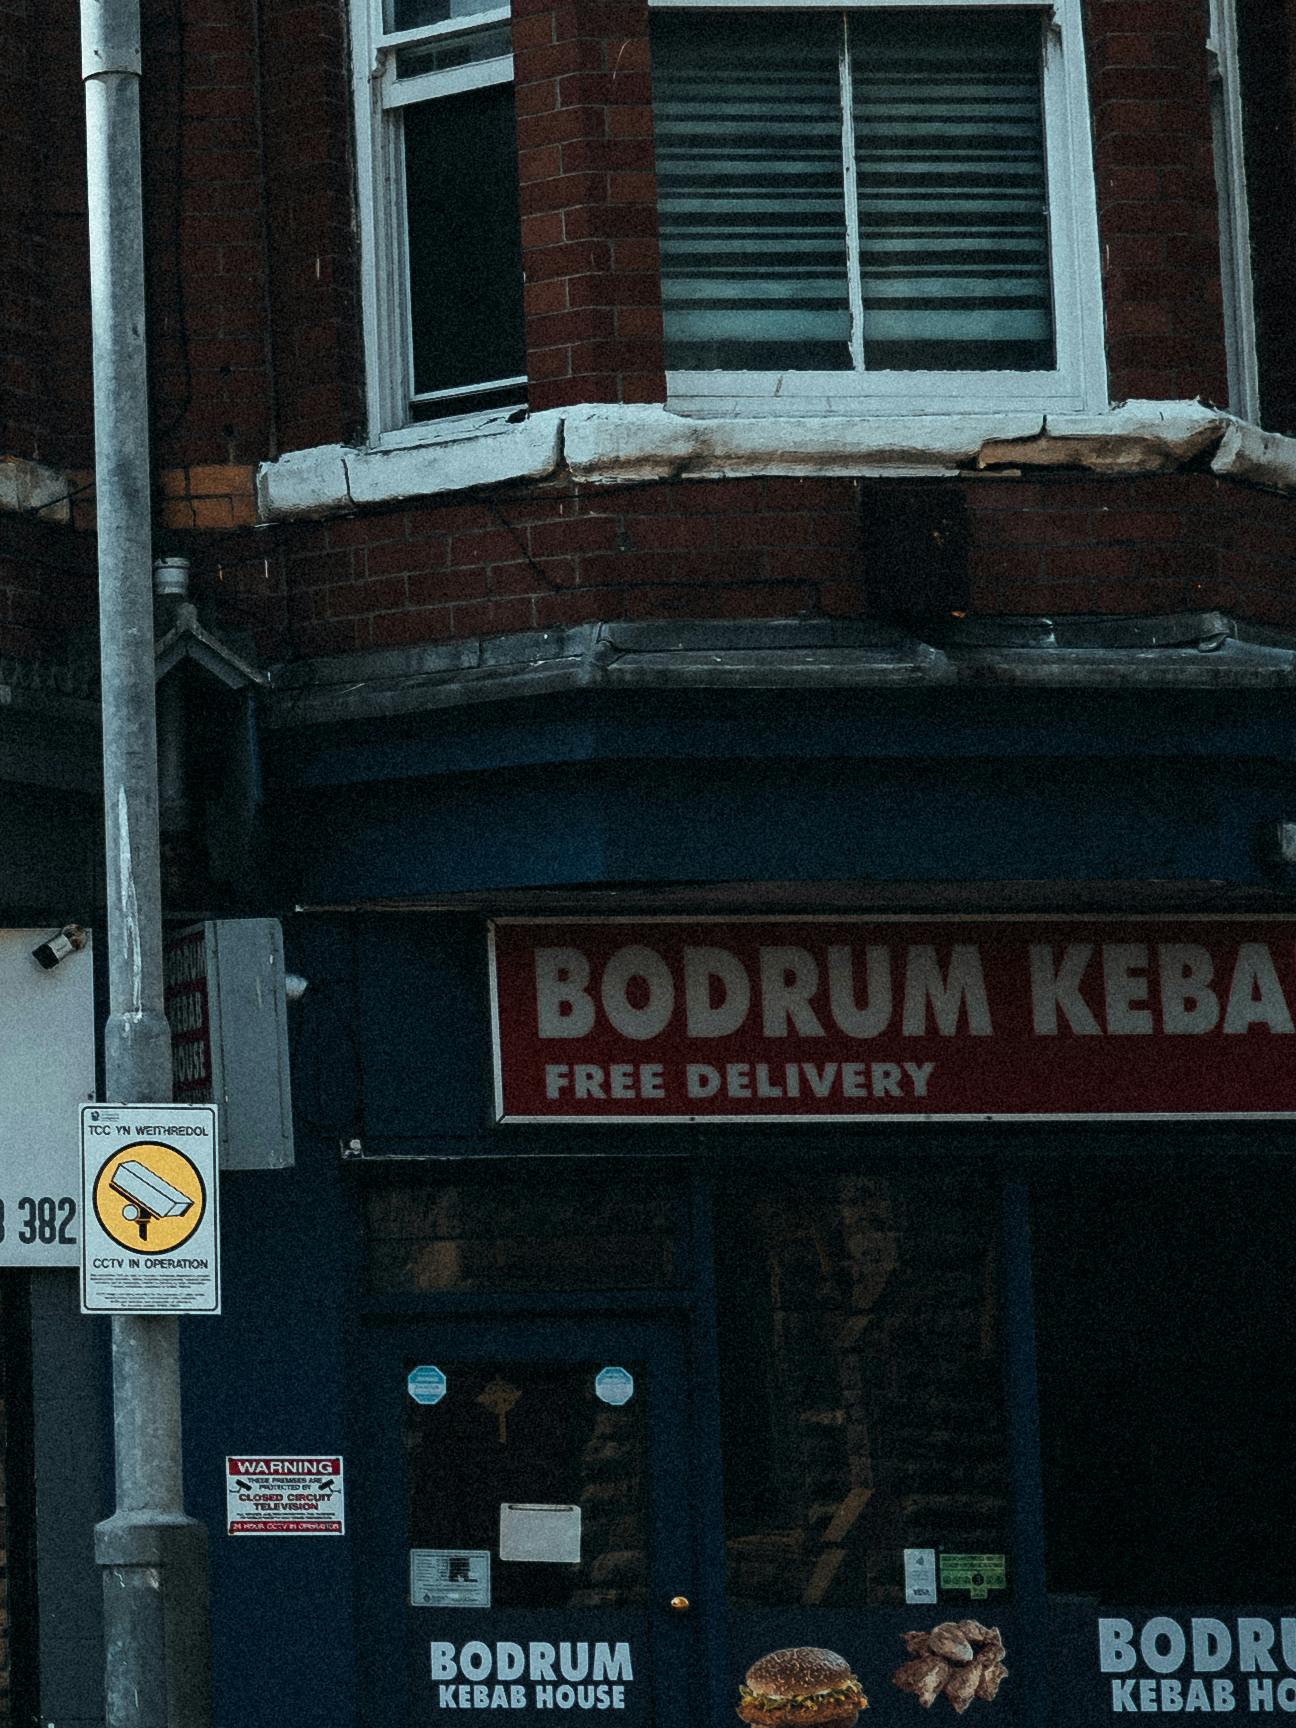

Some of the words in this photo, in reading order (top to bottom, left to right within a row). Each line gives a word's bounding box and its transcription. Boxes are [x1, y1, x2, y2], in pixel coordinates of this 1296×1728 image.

[535, 945, 994, 1040] BODRUM
[544, 1063, 666, 1100] FREE
[686, 1061, 936, 1099] DELIVERY
[88, 1125, 111, 1136] TCC
[116, 1125, 131, 1136] YN
[135, 1125, 209, 1137] WEITHREDOL
[17, 1196, 77, 1245] 382
[92, 1258, 124, 1269] CCTV
[128, 1258, 140, 1269] IN
[144, 1258, 209, 1270] OPERATION
[237, 1461, 333, 1474] WARNING
[238, 1493, 284, 1502] CLOSED
[287, 1493, 333, 1502] CIRCUIT
[253, 1502, 319, 1511] TELEVISION
[430, 1640, 634, 1682] BODRUM
[438, 1684, 527, 1709] KEBAB
[535, 1683, 626, 1710] HOUSE
[1112, 1678, 1236, 1712] KEBAB
